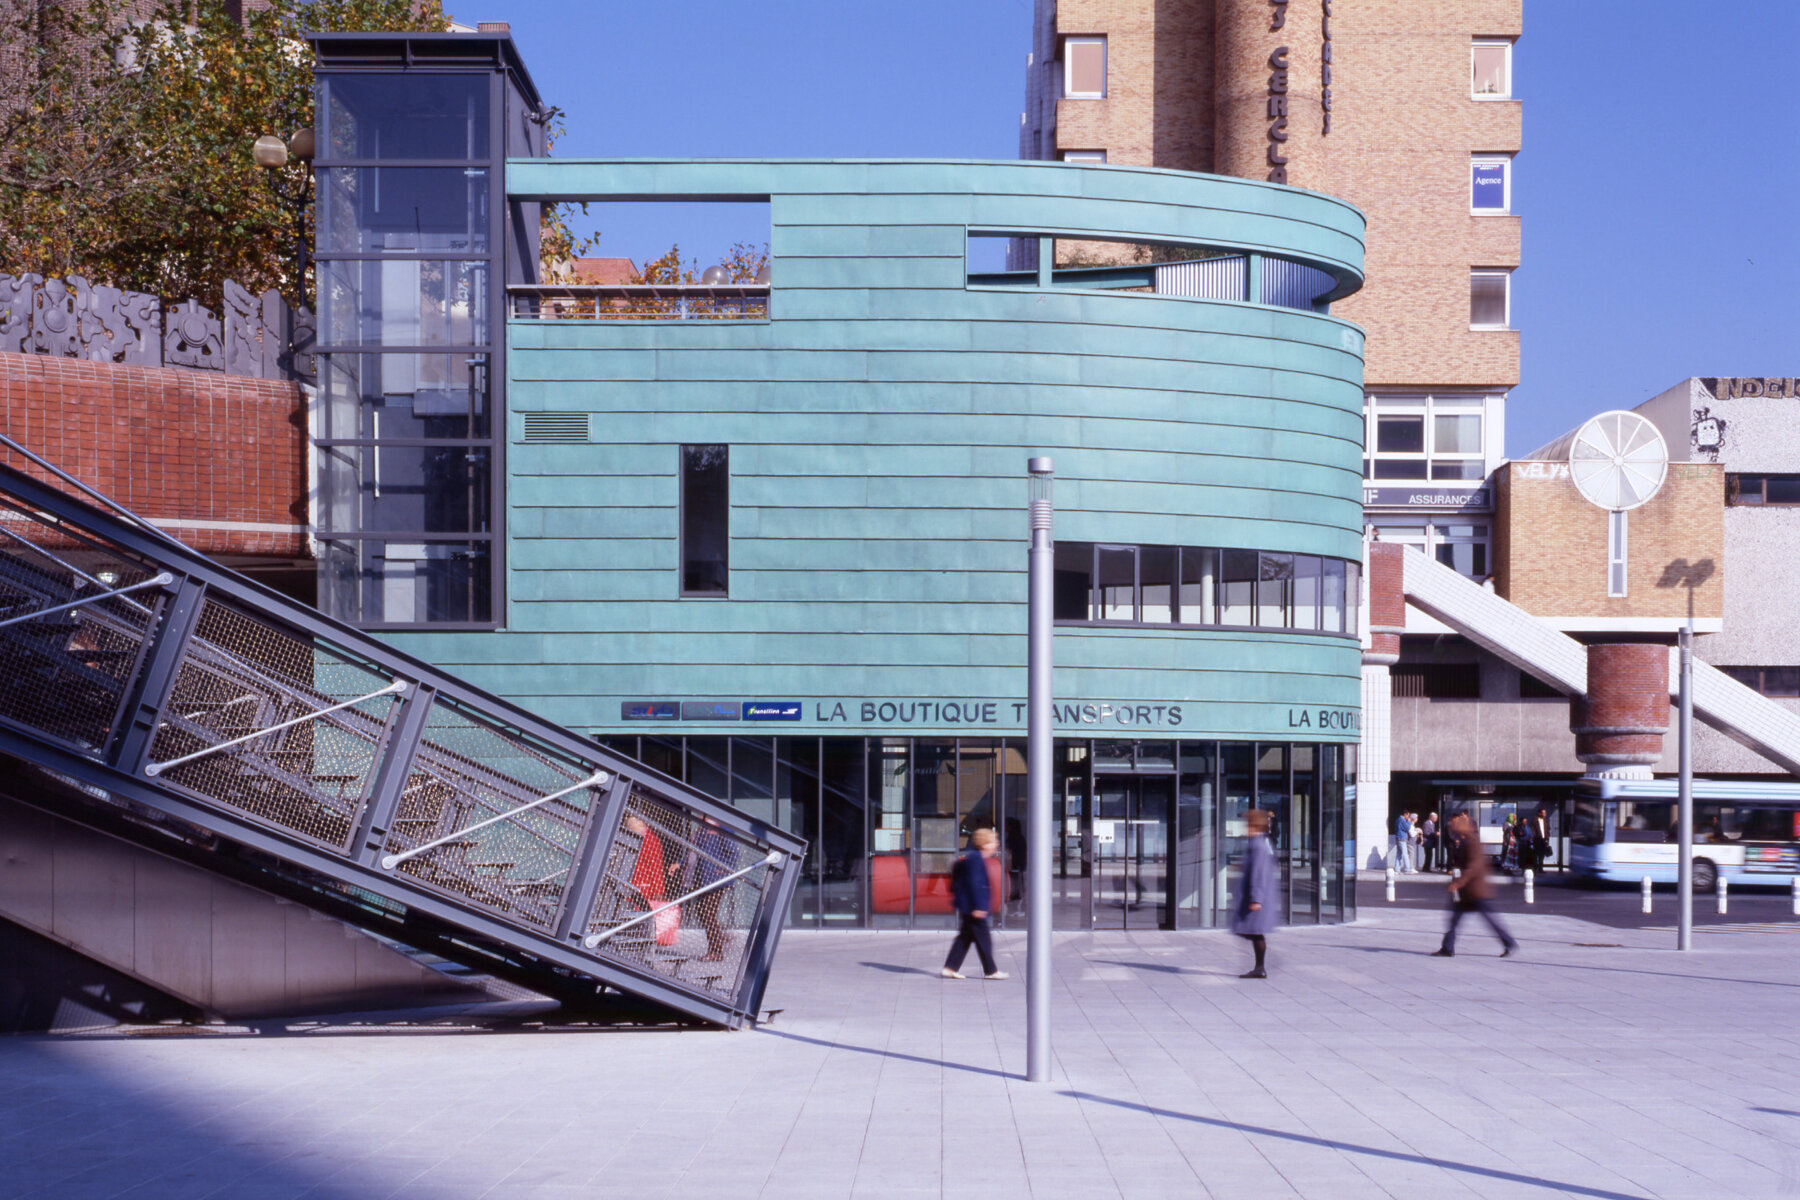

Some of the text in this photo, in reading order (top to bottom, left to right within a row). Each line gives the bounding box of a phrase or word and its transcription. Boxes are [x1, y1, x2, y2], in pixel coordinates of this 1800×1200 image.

[1475, 177, 1502, 186] Agence
[1409, 495, 1481, 504] ASSURANCES
[816, 702, 1183, 725] LA BOUTIQUE TANSPORTS
[1289, 709, 1311, 728] LA
